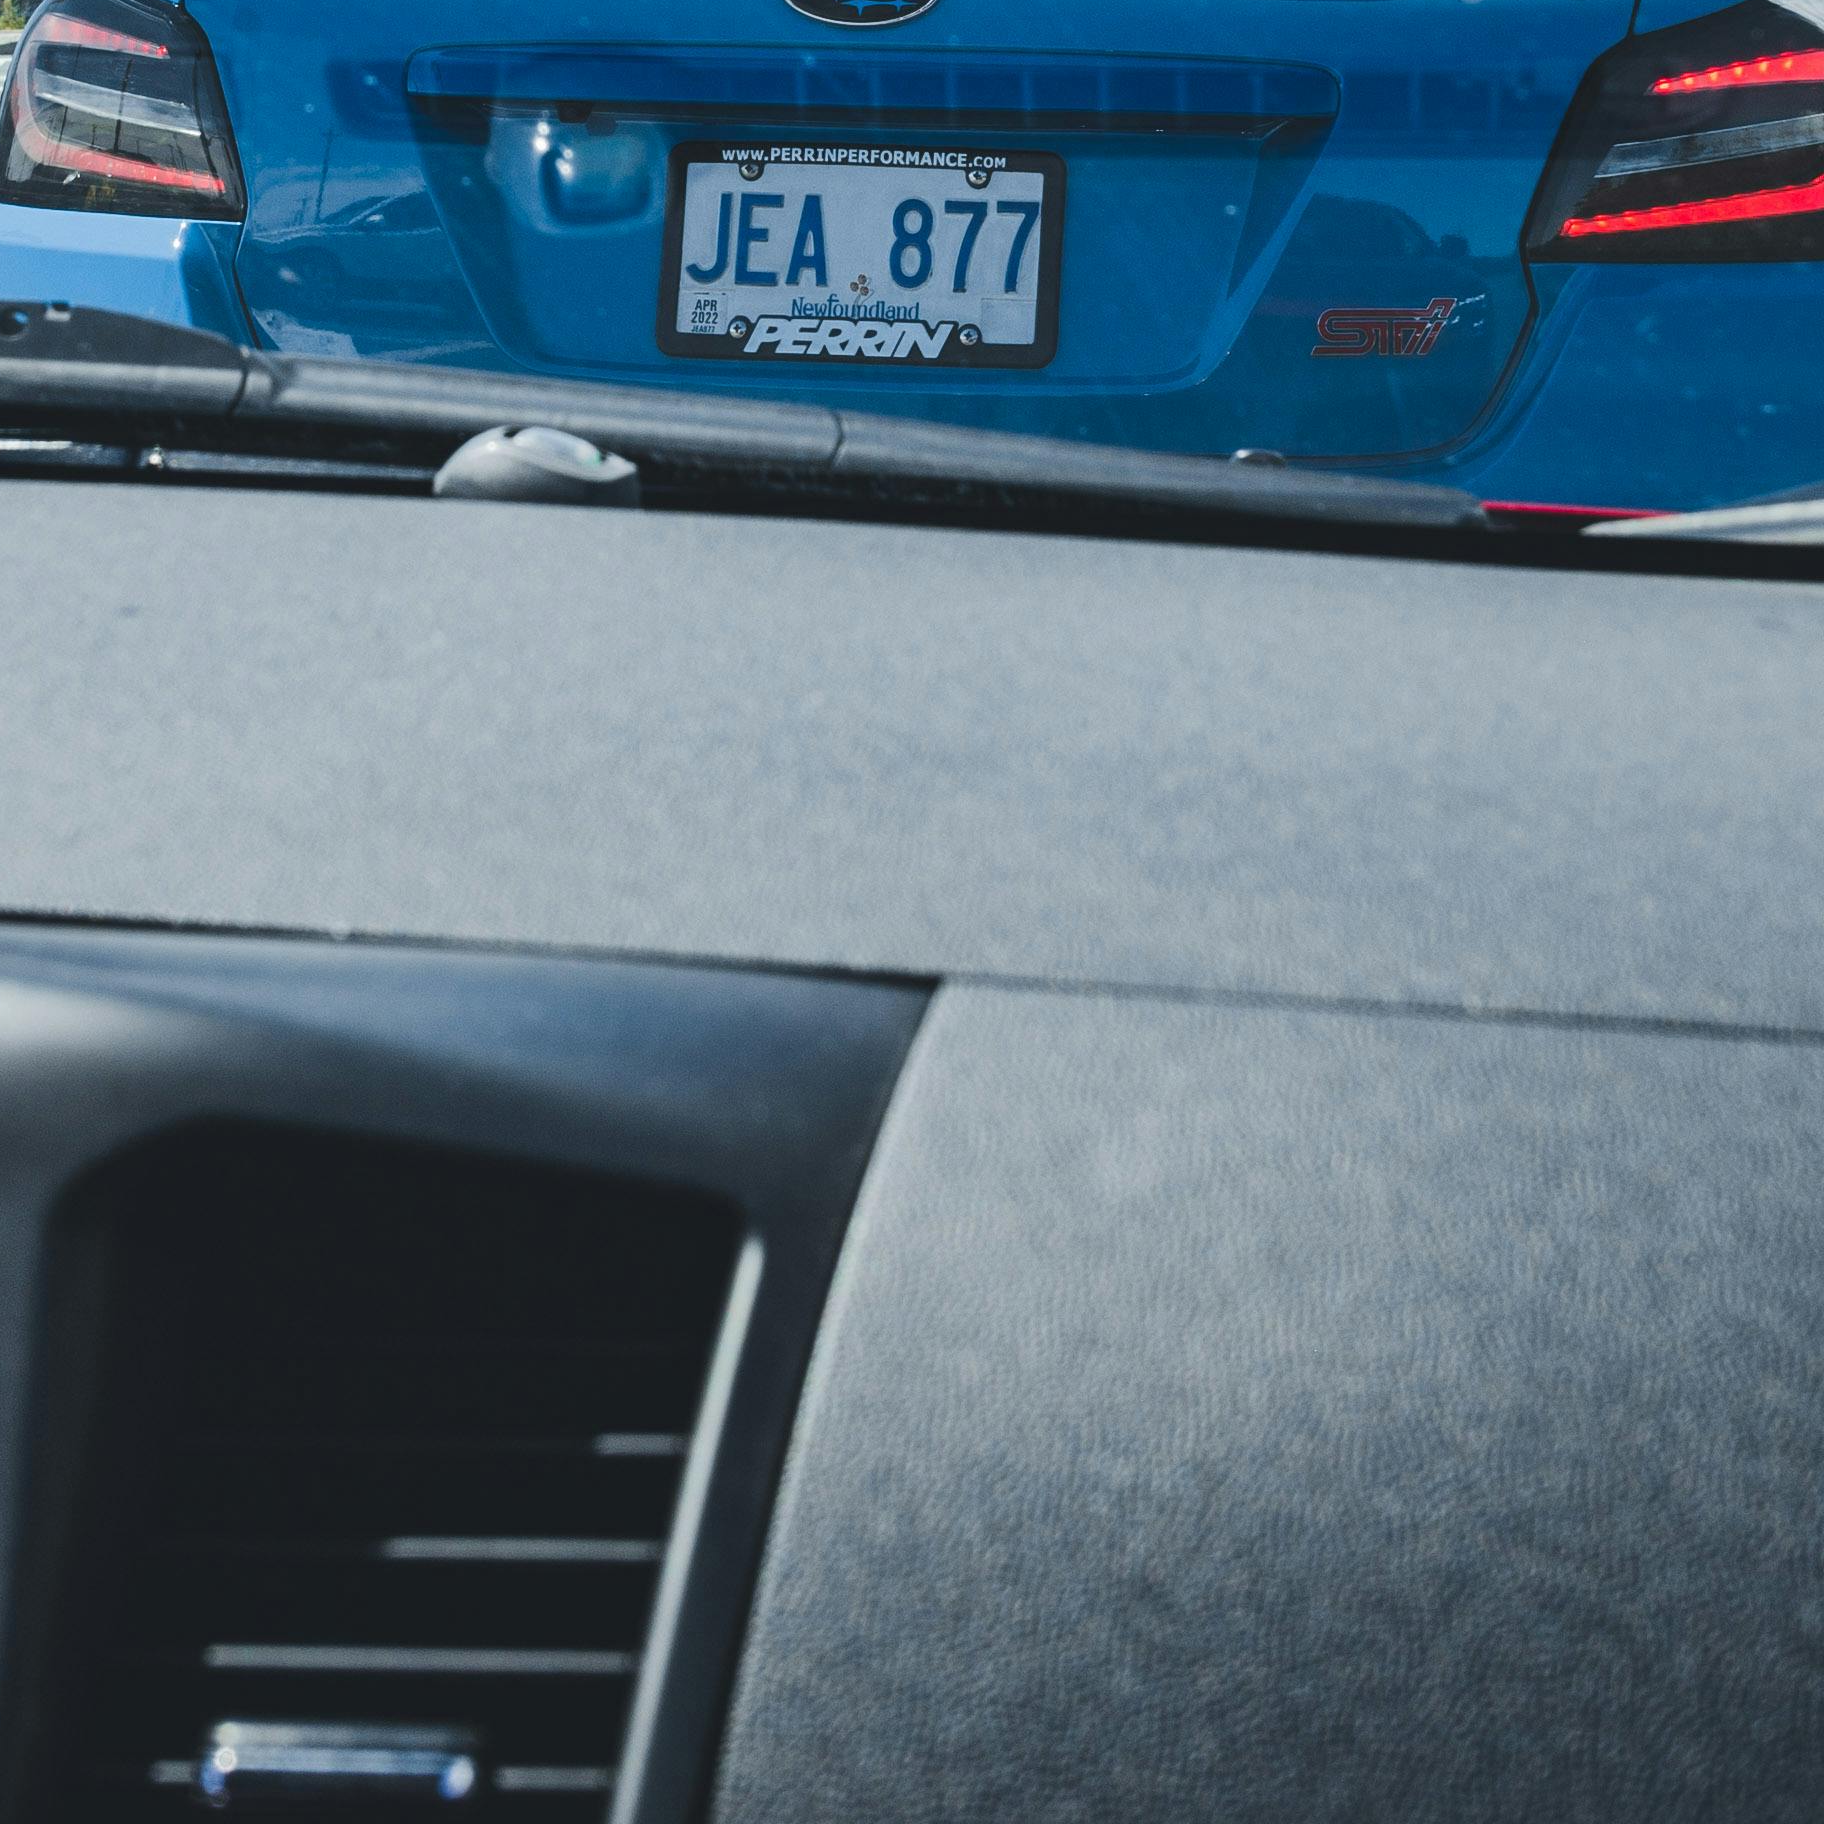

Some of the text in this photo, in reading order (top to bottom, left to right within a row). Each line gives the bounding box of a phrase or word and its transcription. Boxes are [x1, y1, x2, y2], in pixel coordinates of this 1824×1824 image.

[685, 192, 1040, 294] JEA 877
[691, 311, 718, 325] 2022
[695, 298, 718, 311] APR
[791, 293, 920, 320] Newfoundland
[743, 318, 953, 358] PERRIN
